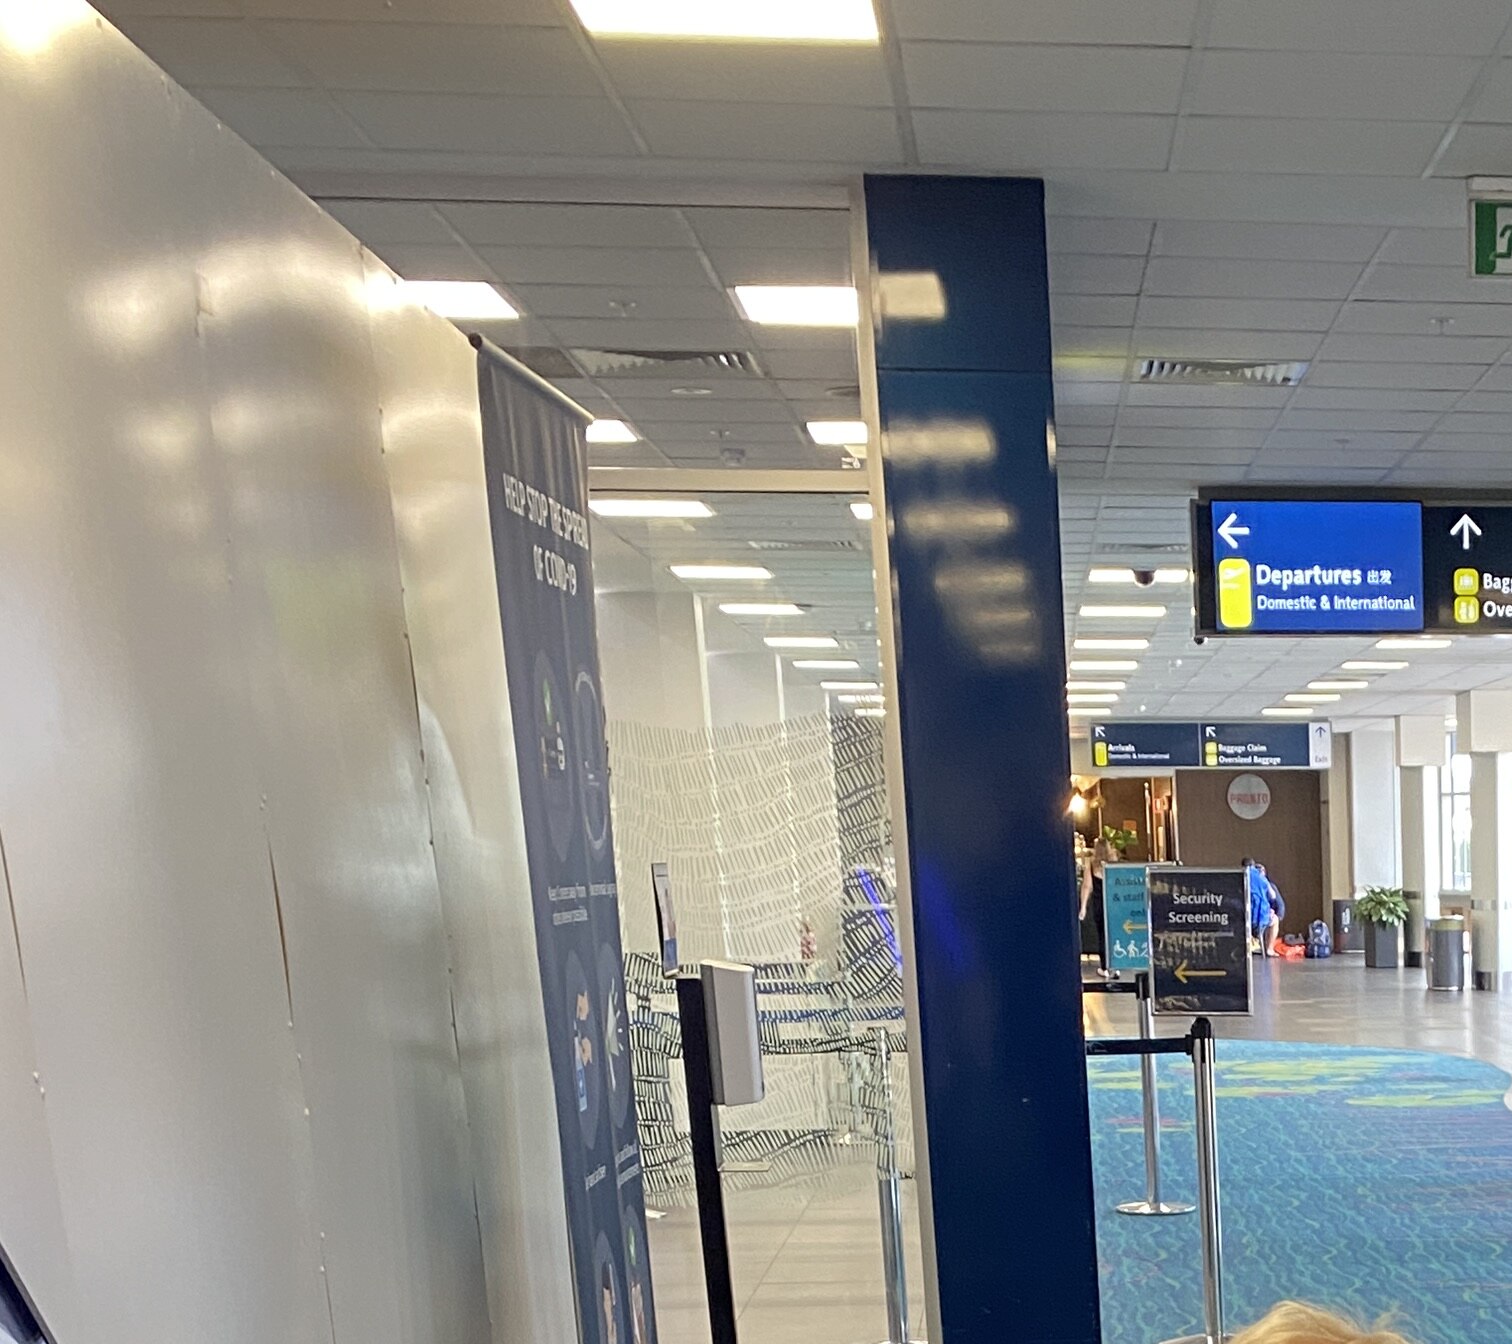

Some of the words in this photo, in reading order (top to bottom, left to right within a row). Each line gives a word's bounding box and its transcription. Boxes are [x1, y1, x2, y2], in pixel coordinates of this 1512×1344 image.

[503, 473, 526, 517] HELP
[526, 485, 548, 528] STOP
[1256, 564, 1362, 590] Departures
[1367, 569, 1392, 585] 出发
[1257, 595, 1316, 610] Domestic
[1320, 595, 1330, 610] &
[1334, 595, 1415, 610] International
[1173, 892, 1223, 906] Security
[1168, 911, 1229, 925] Screening
